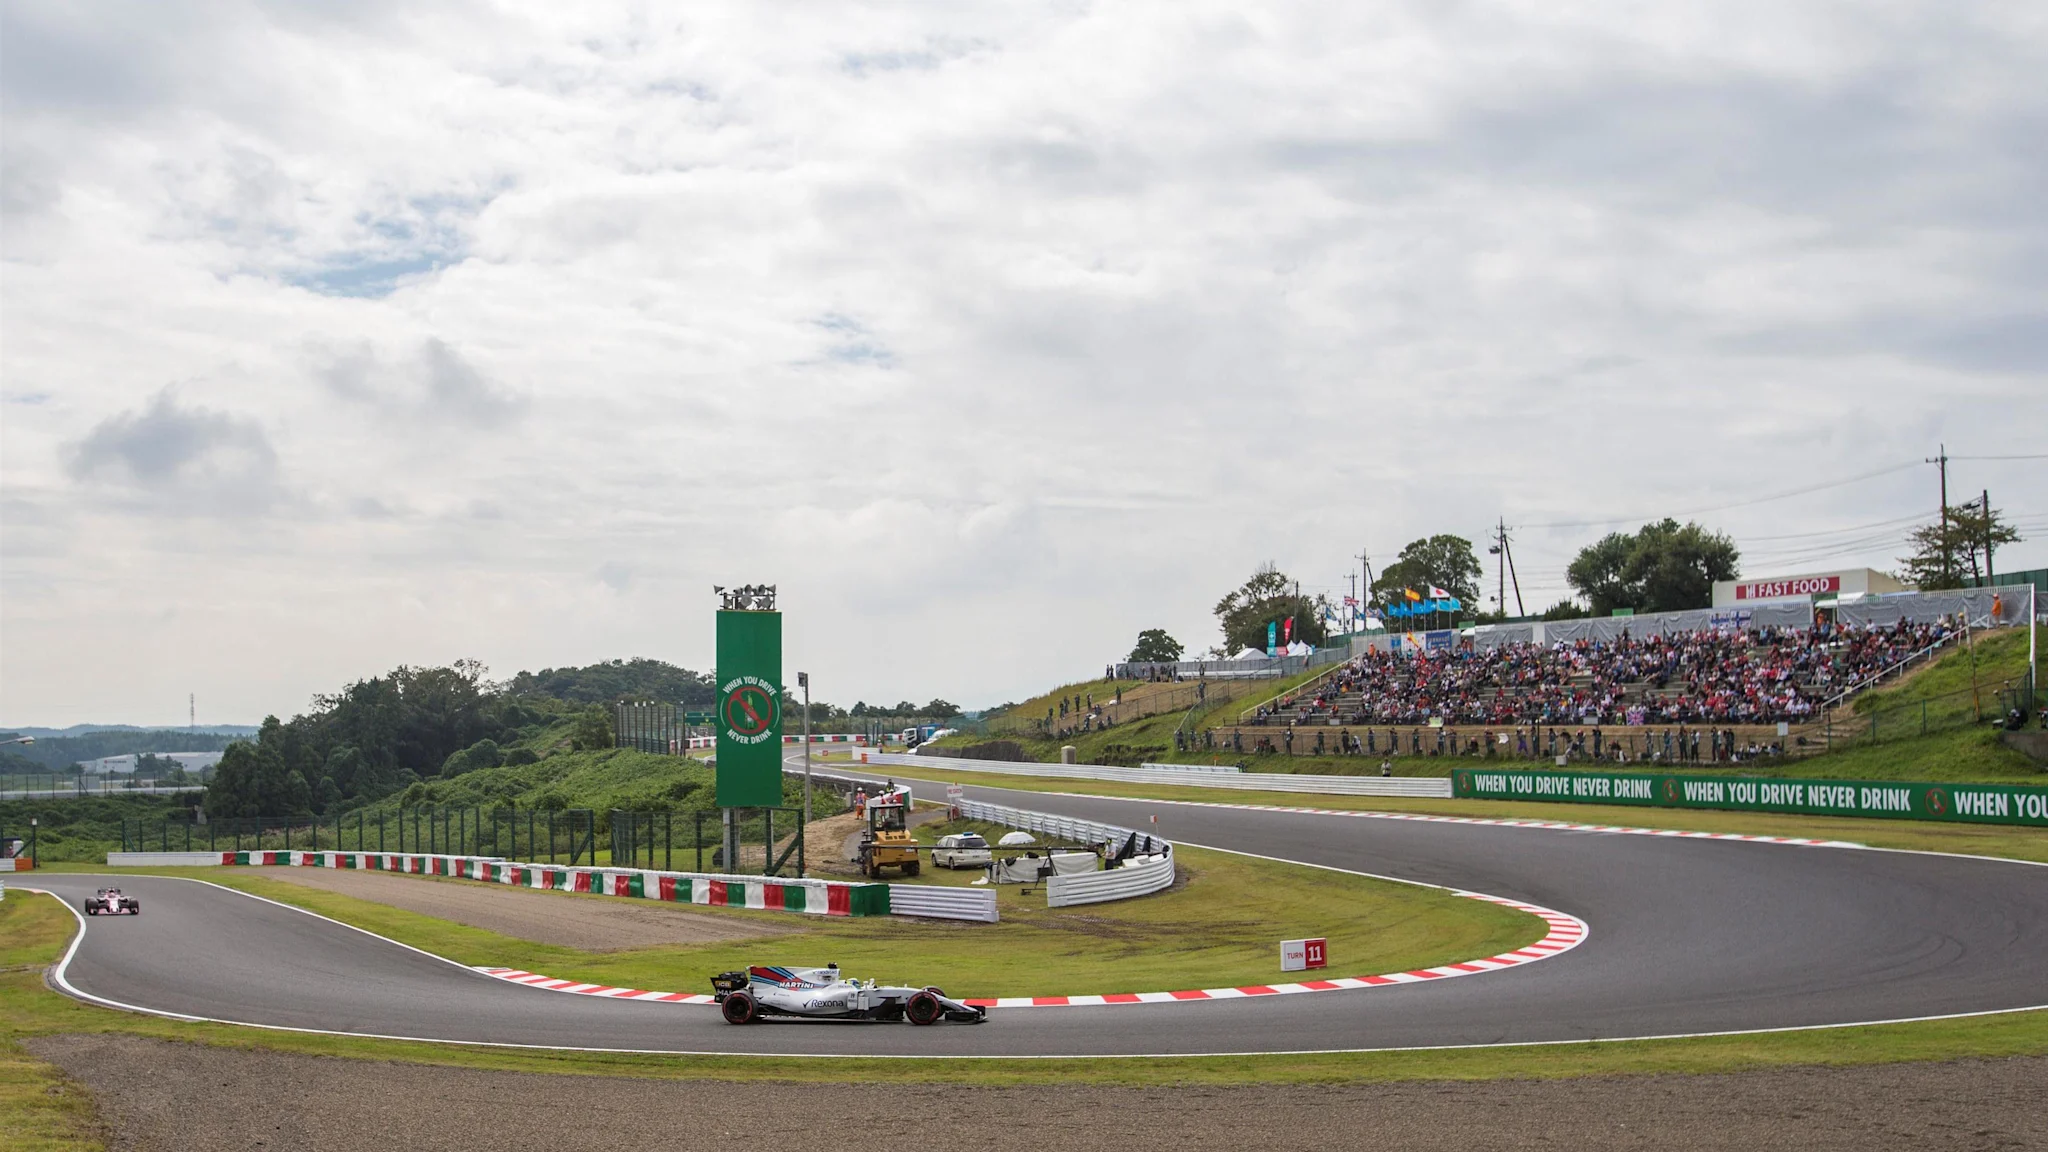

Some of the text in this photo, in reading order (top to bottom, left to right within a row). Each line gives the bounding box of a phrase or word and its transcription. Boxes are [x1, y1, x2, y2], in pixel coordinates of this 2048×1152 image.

[1759, 578, 1830, 597] FAST FOOD
[722, 676, 777, 696] WHEN YOU DRIVE
[726, 729, 772, 744] NEVER DRINK
[1475, 774, 1652, 799] WHEN YOU DRIVE NEVER DRINK
[1684, 781, 1911, 811] WHEN YOU DRIVE NEVER DRINK
[1954, 791, 2008, 816] WHEN
[1287, 946, 1322, 962] TURN 11
[779, 981, 814, 989] MARTINI
[811, 999, 844, 1008] Rexona
